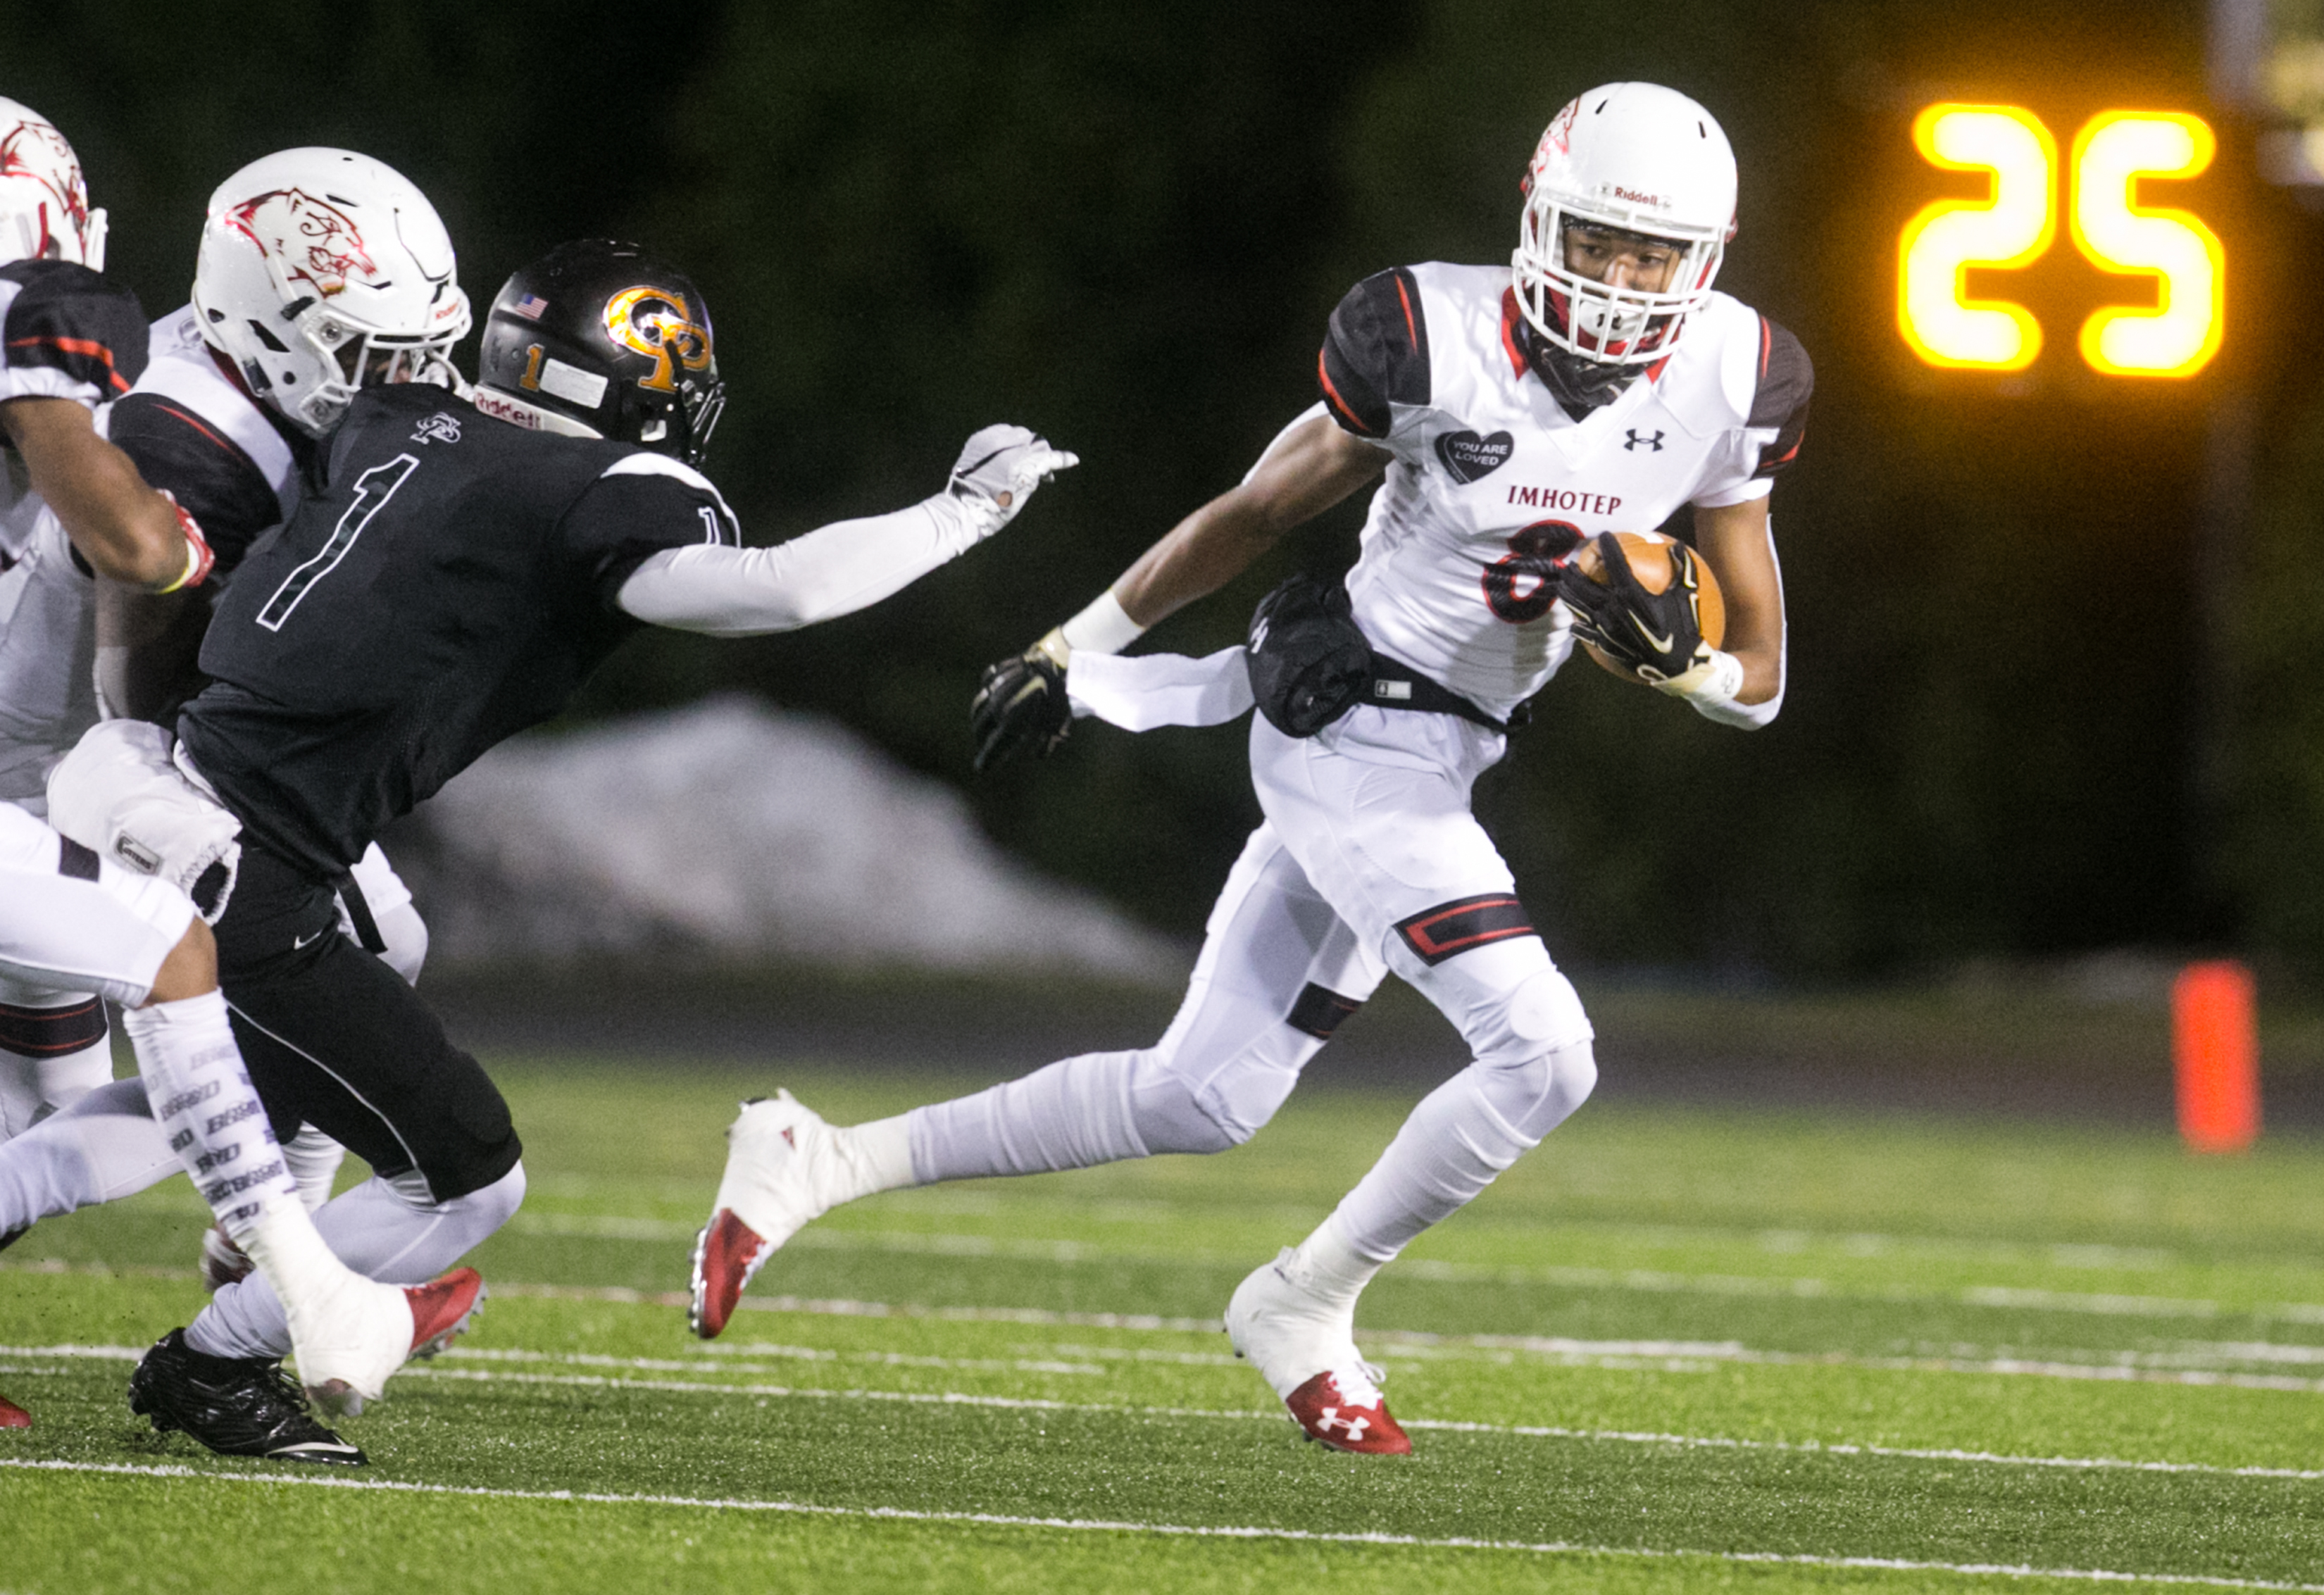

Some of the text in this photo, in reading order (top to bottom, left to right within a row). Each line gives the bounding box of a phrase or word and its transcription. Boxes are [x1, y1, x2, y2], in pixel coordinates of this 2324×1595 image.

[1615, 186, 1658, 206] Riddell
[1899, 103, 2224, 377] 25
[520, 343, 545, 392] 1
[1454, 441, 1508, 455] YOU ARE
[1455, 451, 1499, 466] LOVED
[1507, 485, 1622, 515] IMHOTEP
[698, 506, 721, 544] 1
[256, 453, 420, 632] 1
